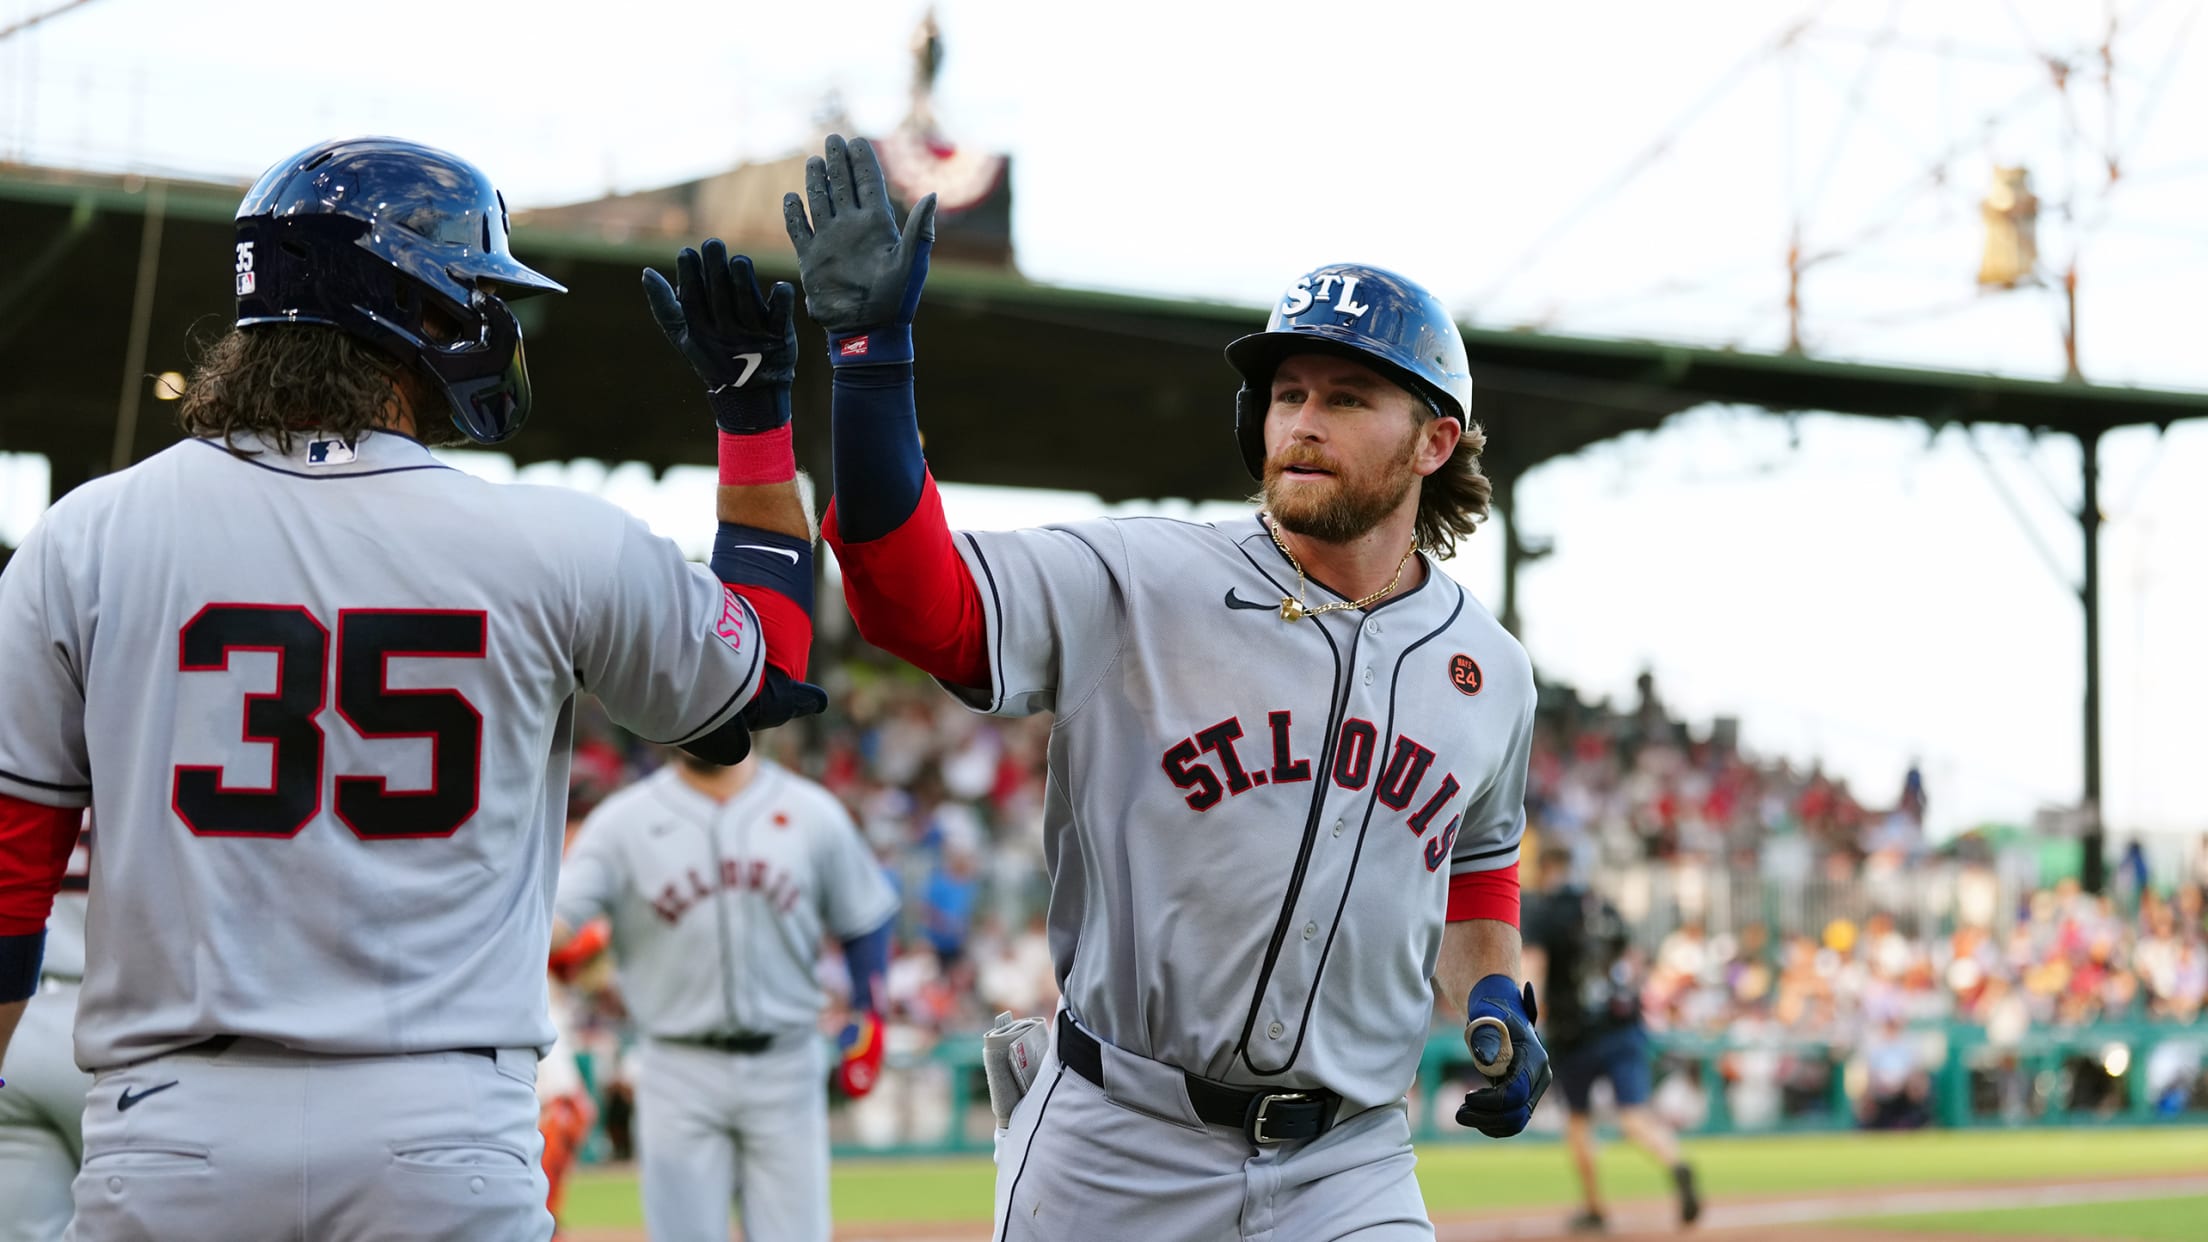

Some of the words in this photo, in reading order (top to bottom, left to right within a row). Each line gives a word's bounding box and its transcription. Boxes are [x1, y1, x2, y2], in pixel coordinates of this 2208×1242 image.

[236, 241, 254, 272] 35
[1282, 275, 1369, 317] STL
[1455, 667, 1477, 688] 24
[171, 602, 488, 840] 35
